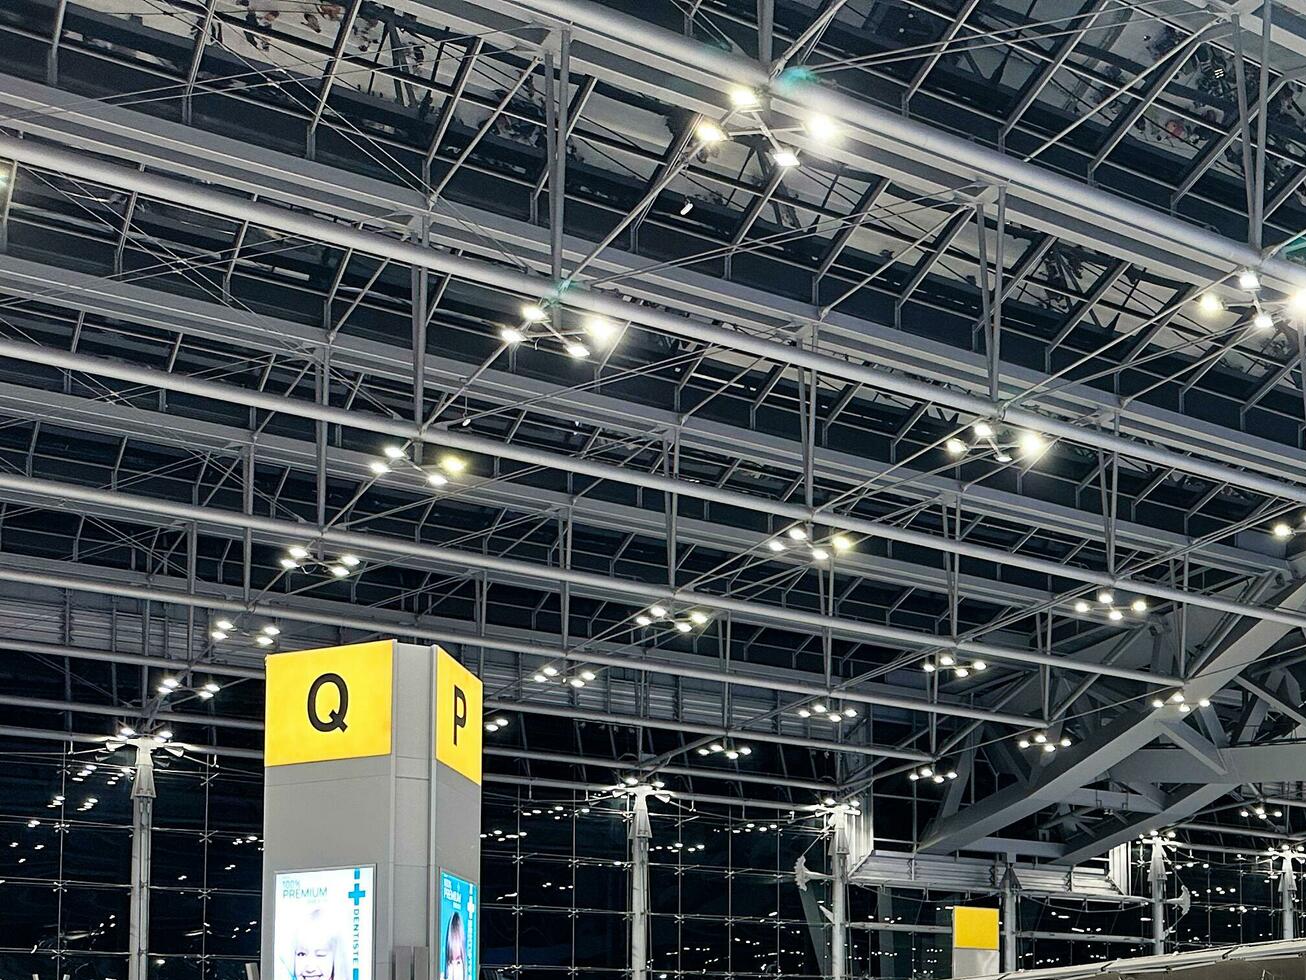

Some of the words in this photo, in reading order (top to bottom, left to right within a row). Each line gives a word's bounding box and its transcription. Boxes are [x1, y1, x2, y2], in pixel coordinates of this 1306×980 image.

[307, 672, 349, 733] Q
[453, 684, 467, 747] P
[282, 887, 328, 899] PREMIUM
[352, 908, 360, 964] DENTISTE
